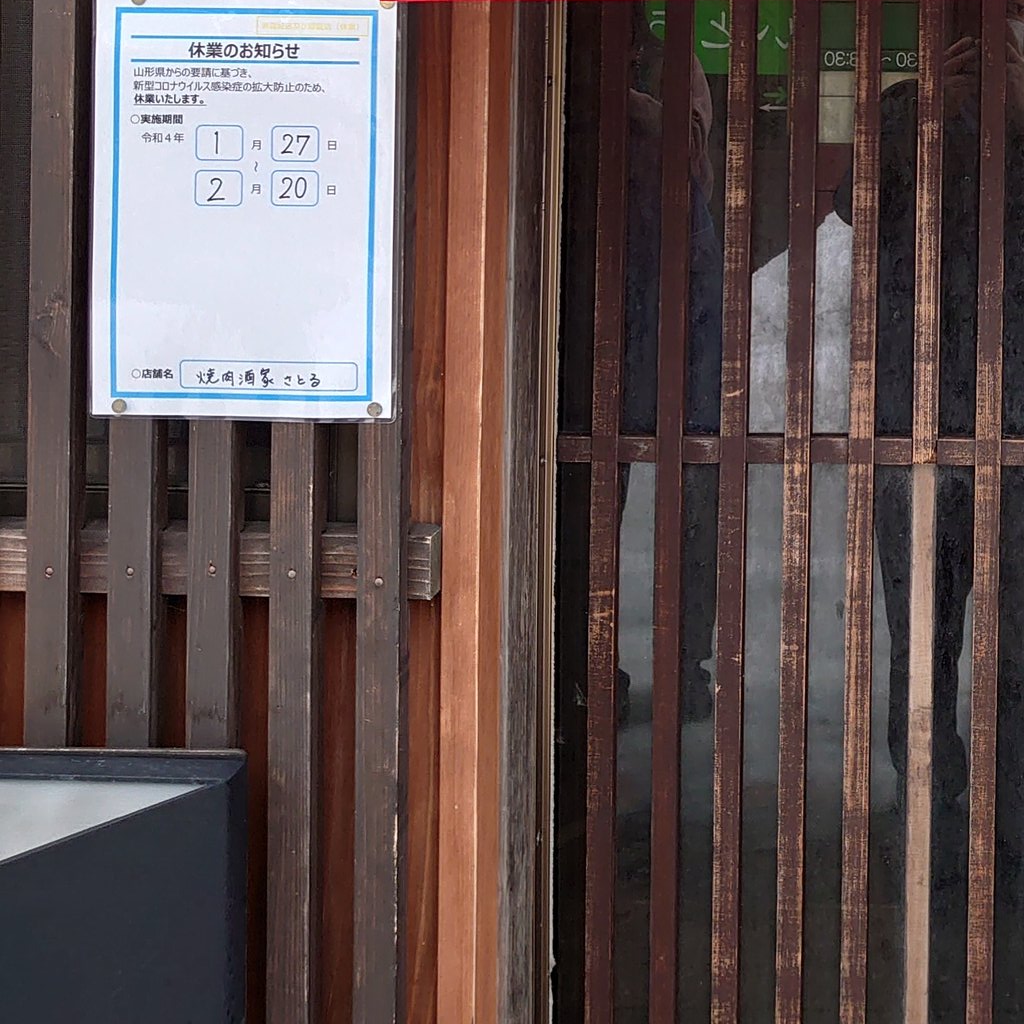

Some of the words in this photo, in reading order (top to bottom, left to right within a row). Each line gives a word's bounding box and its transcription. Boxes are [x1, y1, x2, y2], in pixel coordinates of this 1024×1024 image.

[188, 42, 300, 59] 休業のお知らせ
[133, 67, 252, 78] 山形県からの要請に基づき、
[133, 81, 326, 92] 新型コロナウイルス感染症の拡大防止のため、
[134, 94, 206, 104] 休業いたします。
[141, 132, 184, 143] 令和4年
[251, 140, 262, 150] 月
[281, 133, 310, 156] 27
[328, 141, 337, 151] 日
[207, 178, 225, 202] 2
[251, 184, 262, 194] 月
[278, 176, 308, 199] 20
[327, 185, 336, 195] 日
